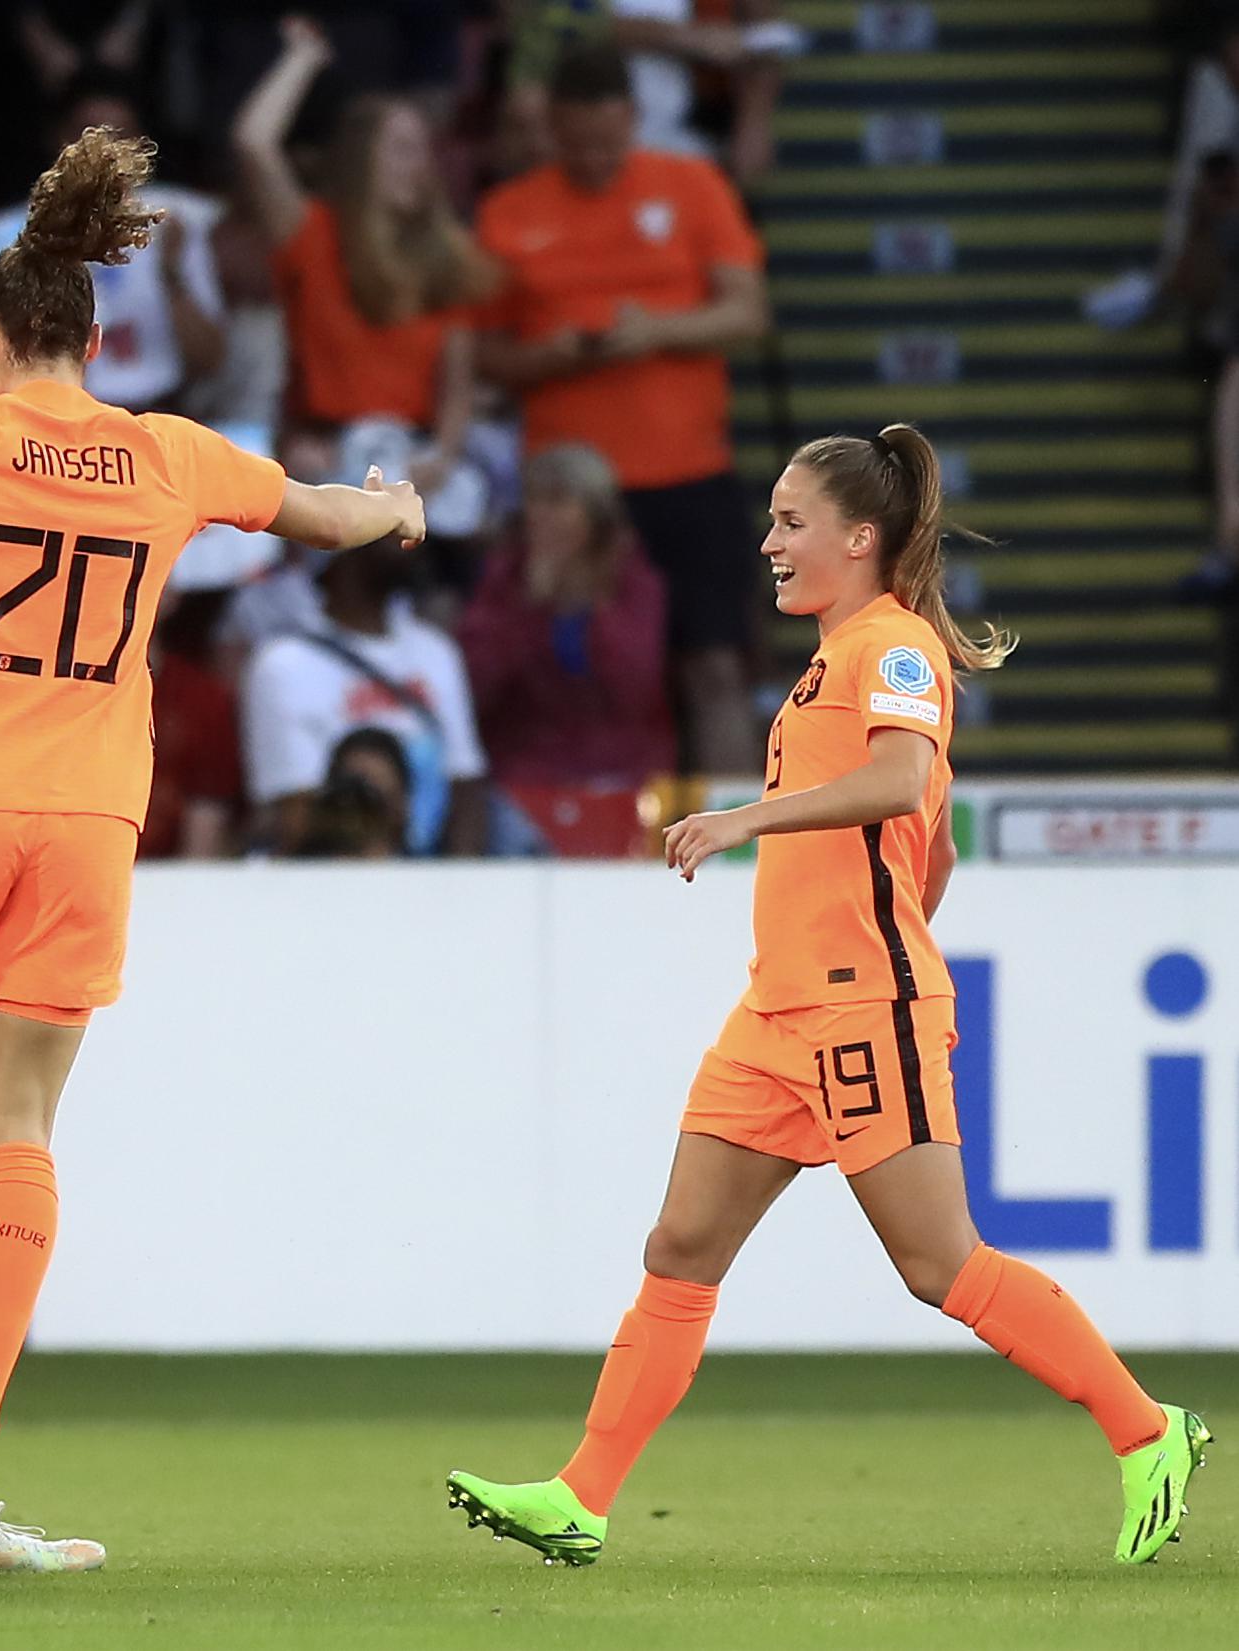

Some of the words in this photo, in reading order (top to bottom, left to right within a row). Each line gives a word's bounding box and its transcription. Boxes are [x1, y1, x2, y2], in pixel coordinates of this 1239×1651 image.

[11, 436, 136, 485] JANSSEN
[814, 1041, 882, 1120] 19
[945, 952, 1239, 1251] Li
